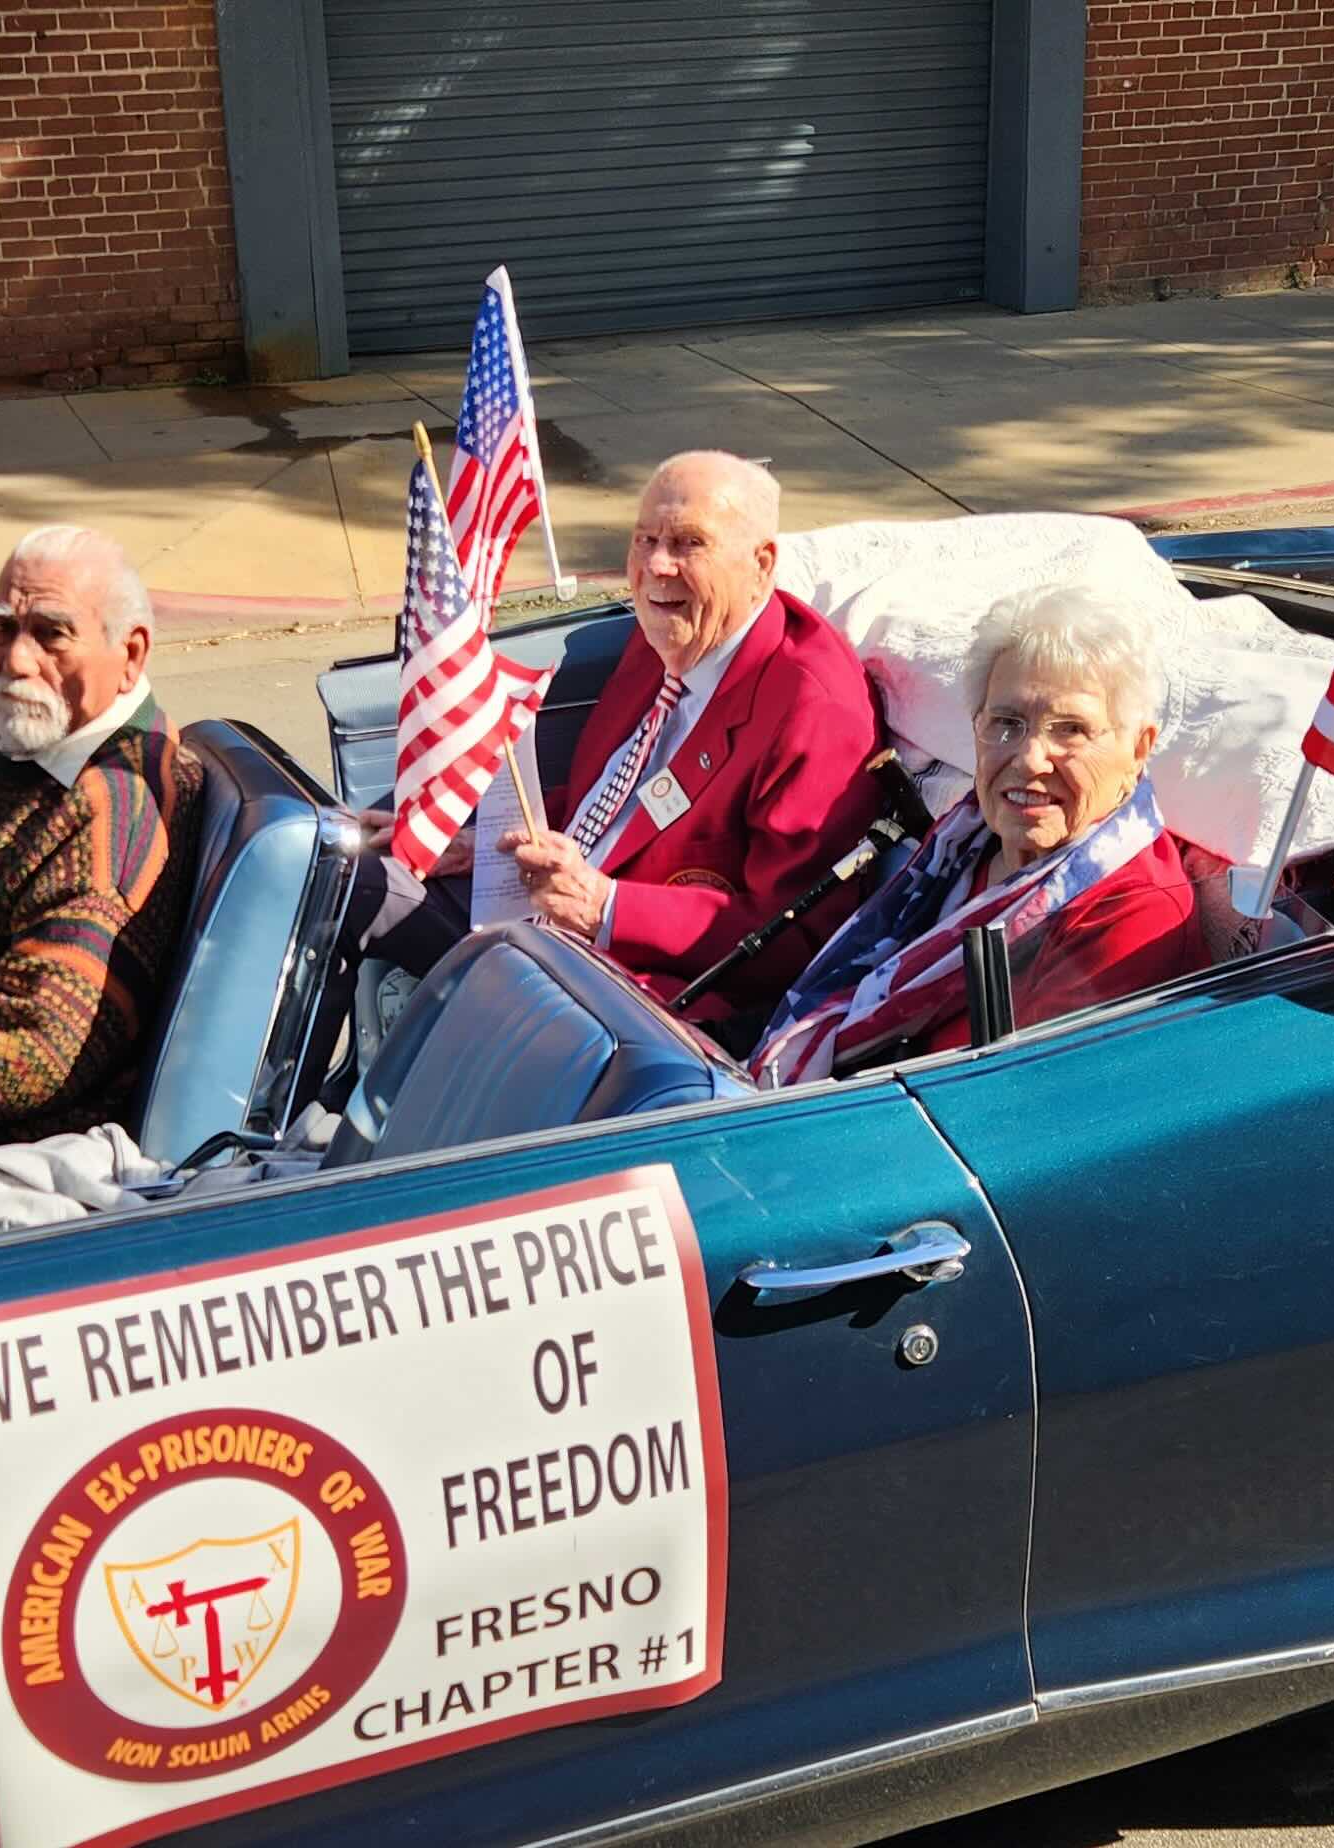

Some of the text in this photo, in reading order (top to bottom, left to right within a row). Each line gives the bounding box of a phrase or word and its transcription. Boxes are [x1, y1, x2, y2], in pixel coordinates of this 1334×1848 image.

[77, 1264, 399, 1402] REMEMBER
[395, 1238, 511, 1329] THE
[513, 1205, 666, 1306] PRICE
[533, 1330, 599, 1415] OF
[442, 1420, 691, 1550] FREEDOM
[19, 1424, 393, 1686] AMERICAN EX-PRISONERS OF WAR
[127, 1576, 147, 1609] A
[269, 1538, 289, 1573] X
[233, 1637, 260, 1667] W
[436, 1566, 662, 1658] FRESNO
[180, 1655, 197, 1683] P
[353, 1627, 694, 1742] CHAPTER #1
[105, 1684, 332, 1769] NON SOLUM ARMIS
